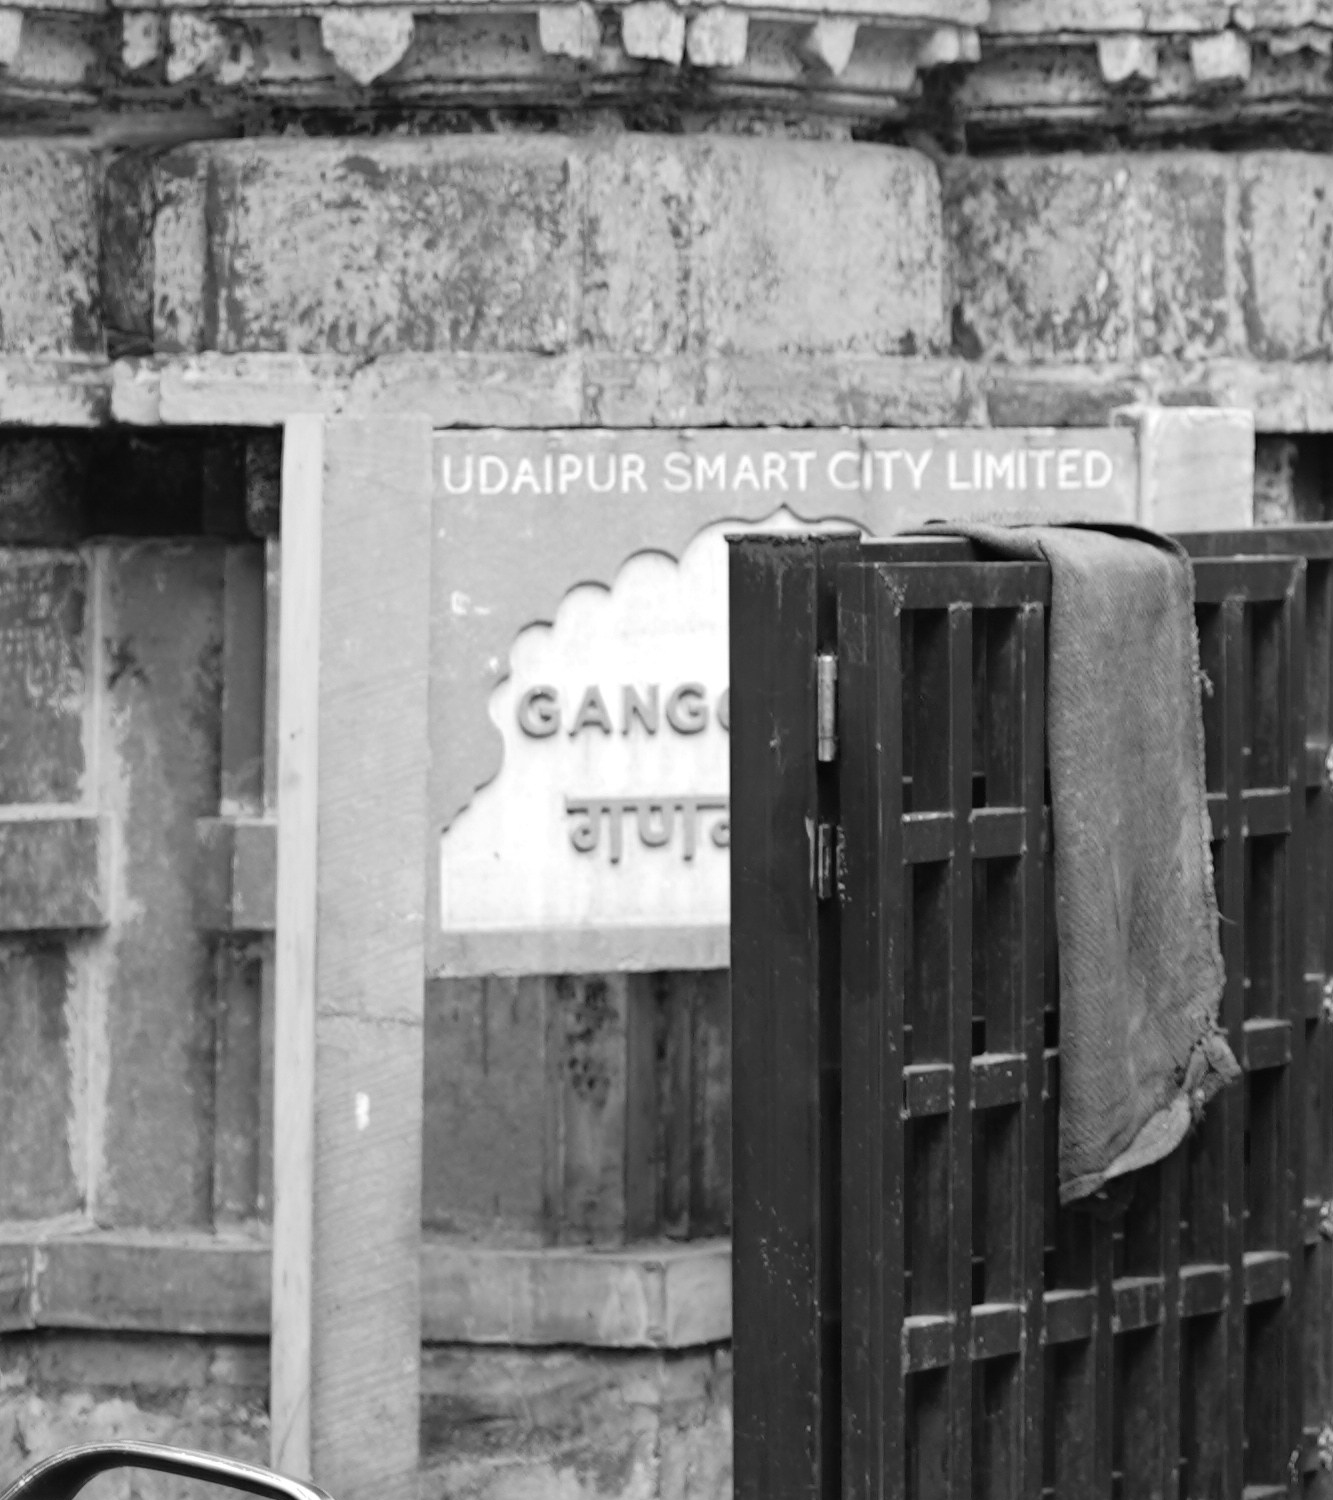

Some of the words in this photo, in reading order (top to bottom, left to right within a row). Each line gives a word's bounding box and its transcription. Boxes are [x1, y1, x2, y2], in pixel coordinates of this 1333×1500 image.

[442, 452, 648, 494] UDAIPUR
[663, 450, 817, 492] SMART
[827, 448, 933, 491] CITY
[948, 447, 1114, 490] LIMITED
